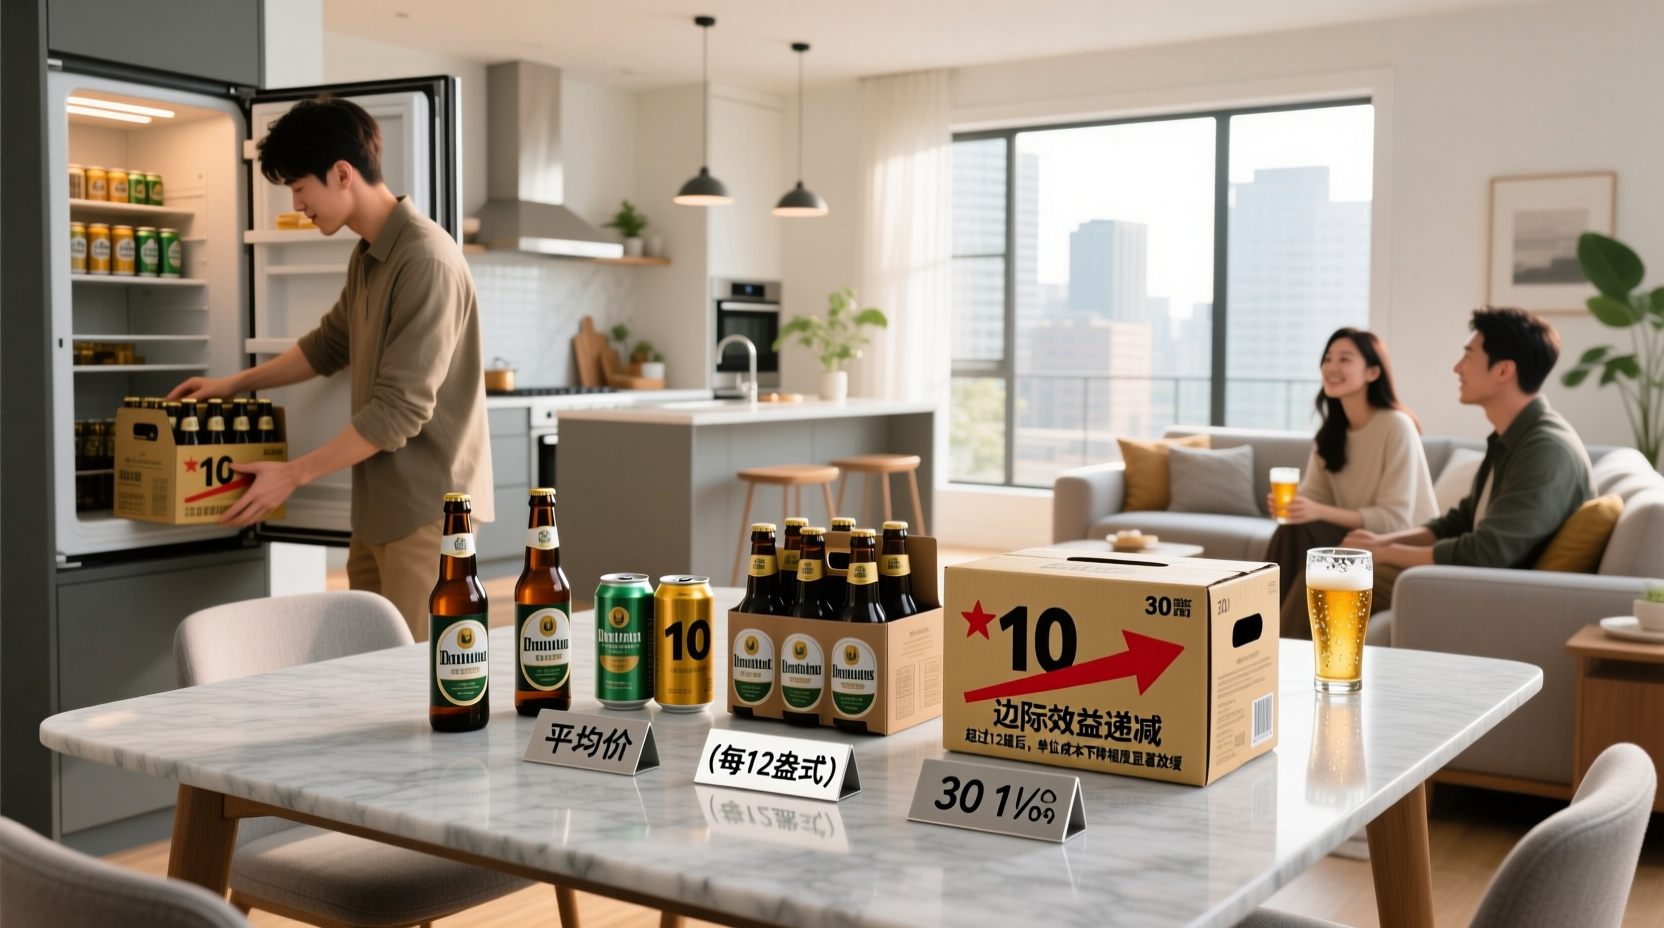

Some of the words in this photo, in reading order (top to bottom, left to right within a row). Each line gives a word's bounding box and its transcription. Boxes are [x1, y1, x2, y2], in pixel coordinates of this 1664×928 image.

[200, 455, 234, 487] 10
[1145, 595, 1171, 616] 30
[664, 619, 711, 661] 10
[999, 606, 1077, 672] 10
[993, 698, 1163, 747] 边际效益递减
[545, 723, 633, 762] 平均价
[934, 776, 984, 814] 30
